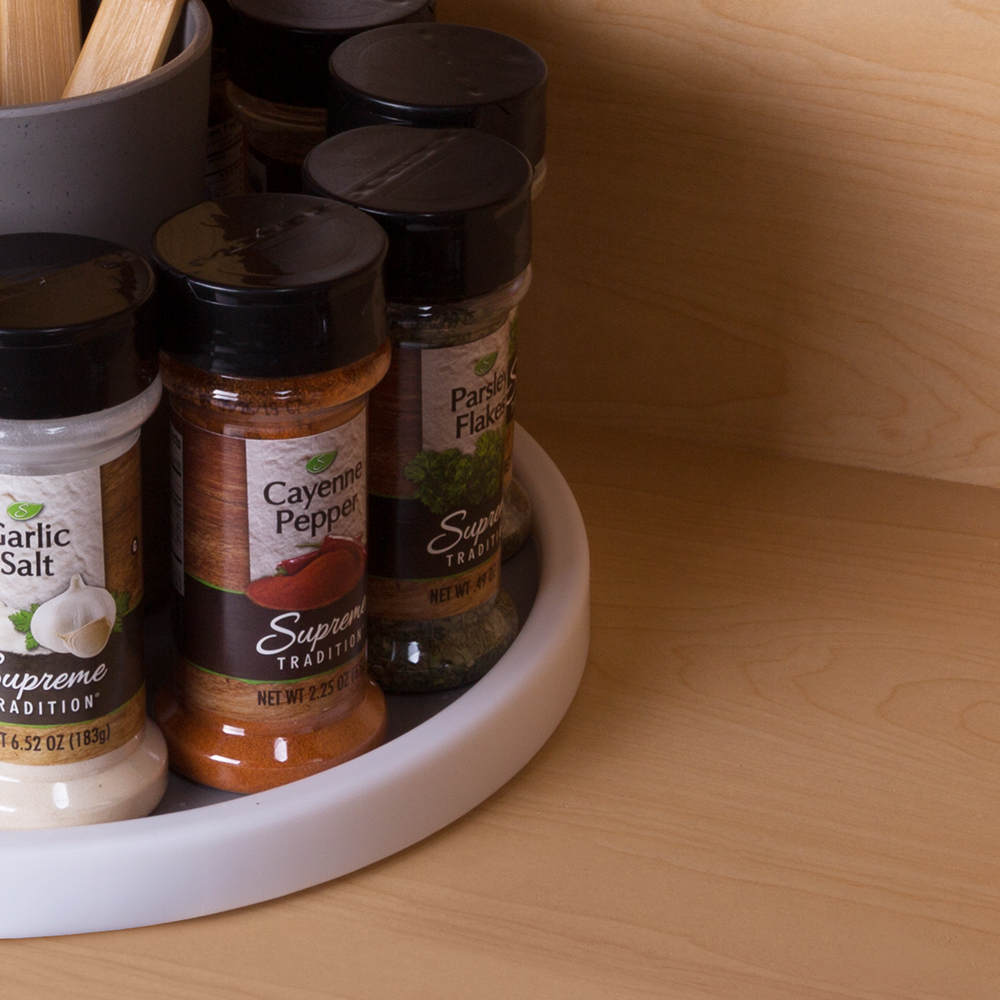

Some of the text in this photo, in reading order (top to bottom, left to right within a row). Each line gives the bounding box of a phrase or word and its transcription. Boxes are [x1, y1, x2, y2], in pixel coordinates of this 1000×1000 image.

[263, 460, 363, 511] Cayenne
[276, 491, 359, 538] Pepper
[427, 498, 503, 555] Supre
[0, 550, 55, 578] Salt
[446, 525, 501, 567] TRADITI
[277, 627, 362, 671] TRADITION
[257, 690, 281, 706] NET
[285, 688, 305, 705] WT
[309, 680, 334, 701] 2.25
[11, 734, 42, 752] 6.52
[46, 734, 65, 752] OZ
[69, 723, 111, 751] (183g)
